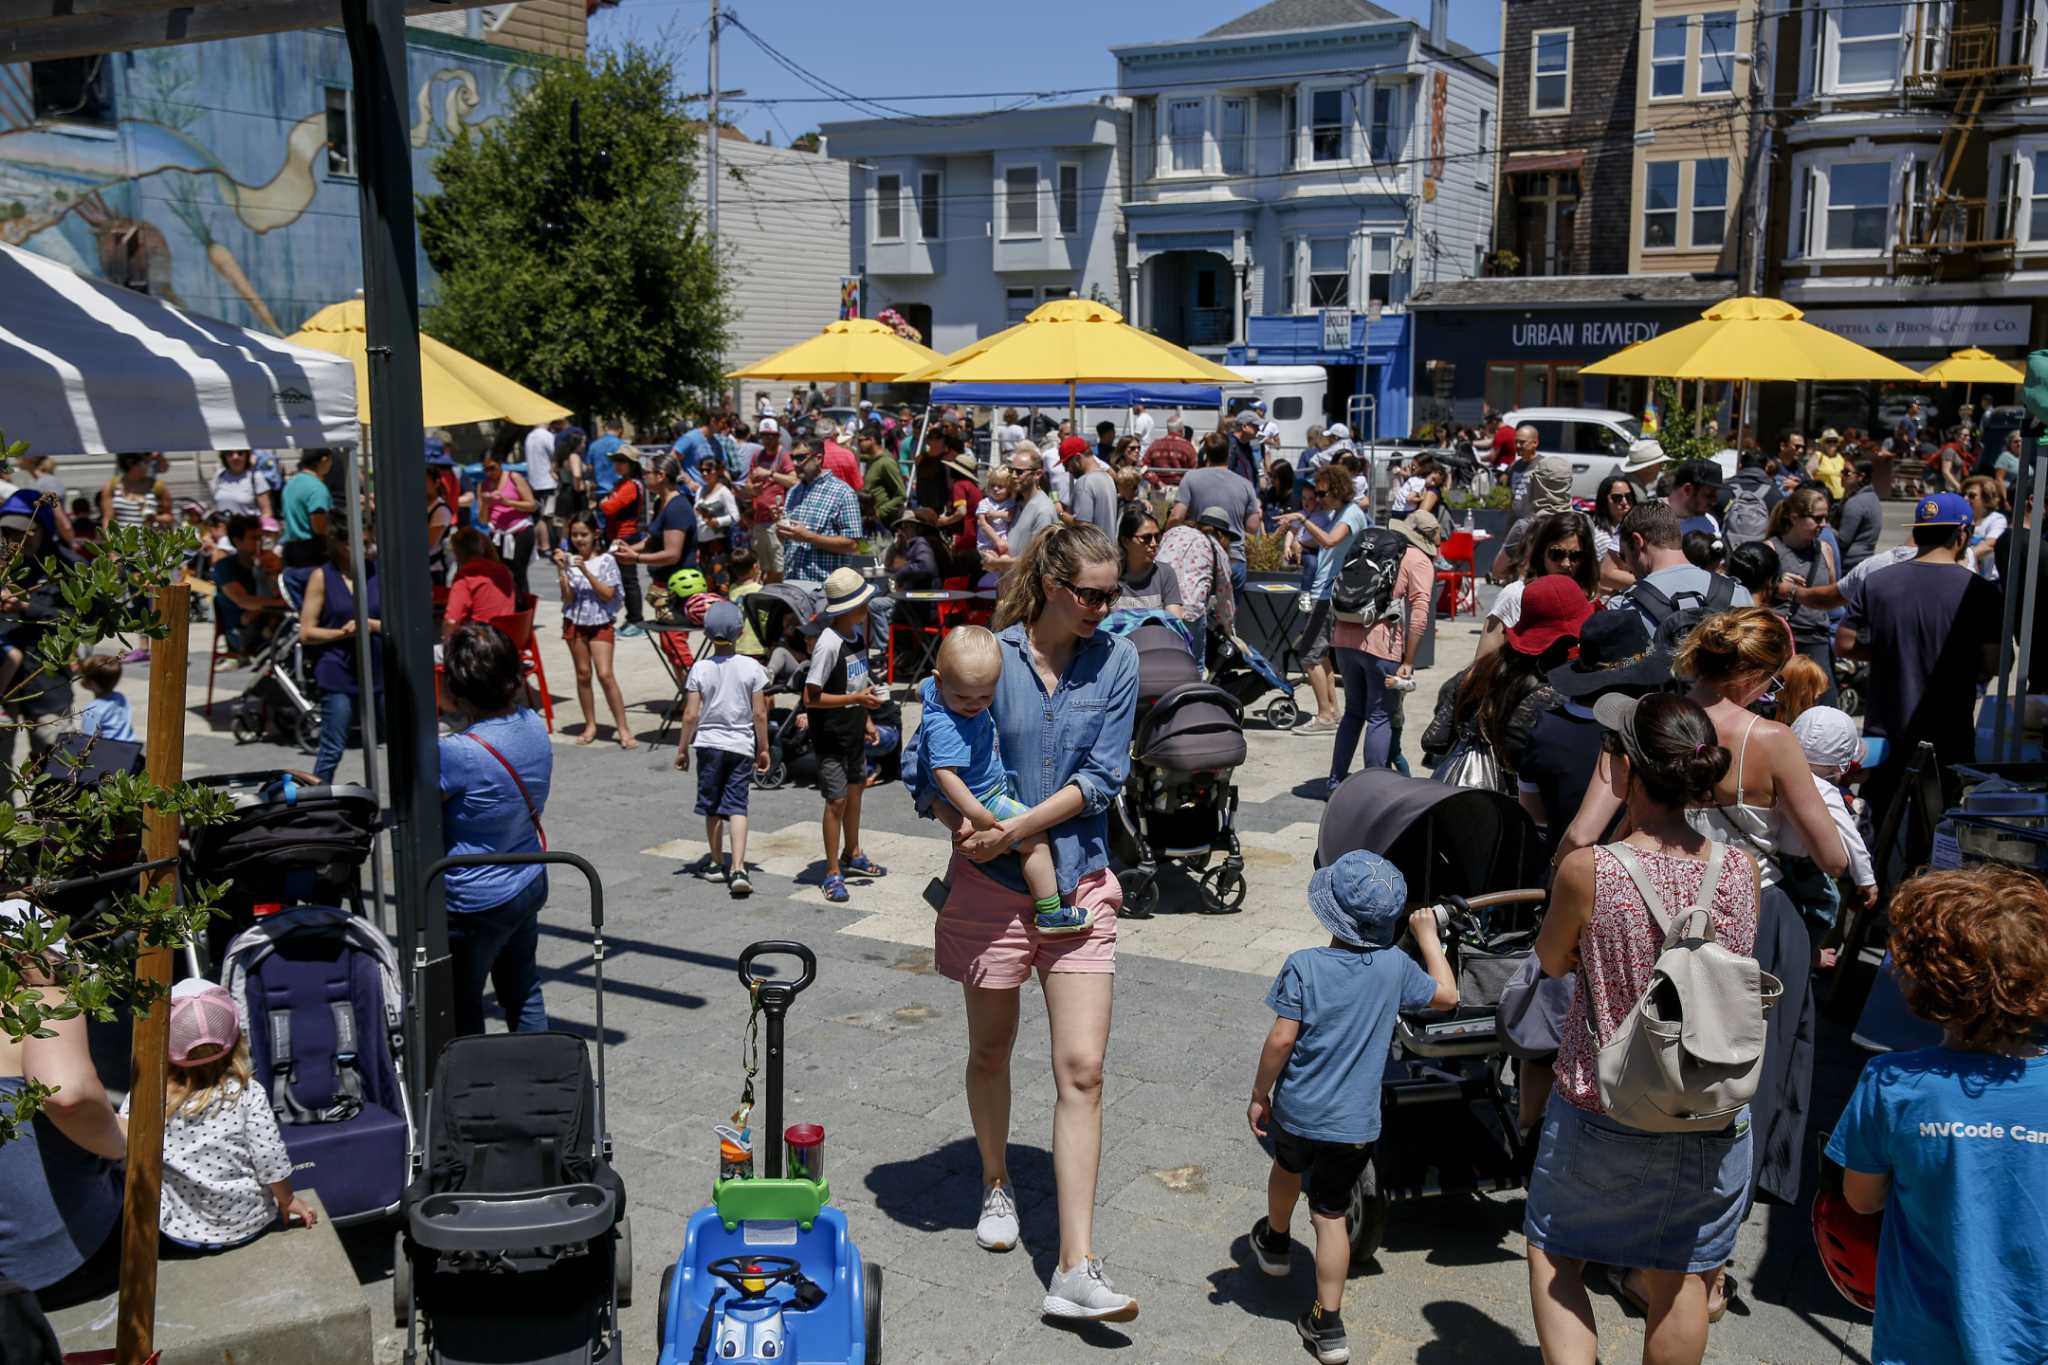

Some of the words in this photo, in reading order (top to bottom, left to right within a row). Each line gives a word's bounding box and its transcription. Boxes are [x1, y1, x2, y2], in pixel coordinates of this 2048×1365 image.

[1512, 324, 1574, 346] URBAN
[1582, 322, 1660, 345] REMEDY
[1876, 321, 1888, 334] &
[1919, 1122, 2004, 1138] MVCode
